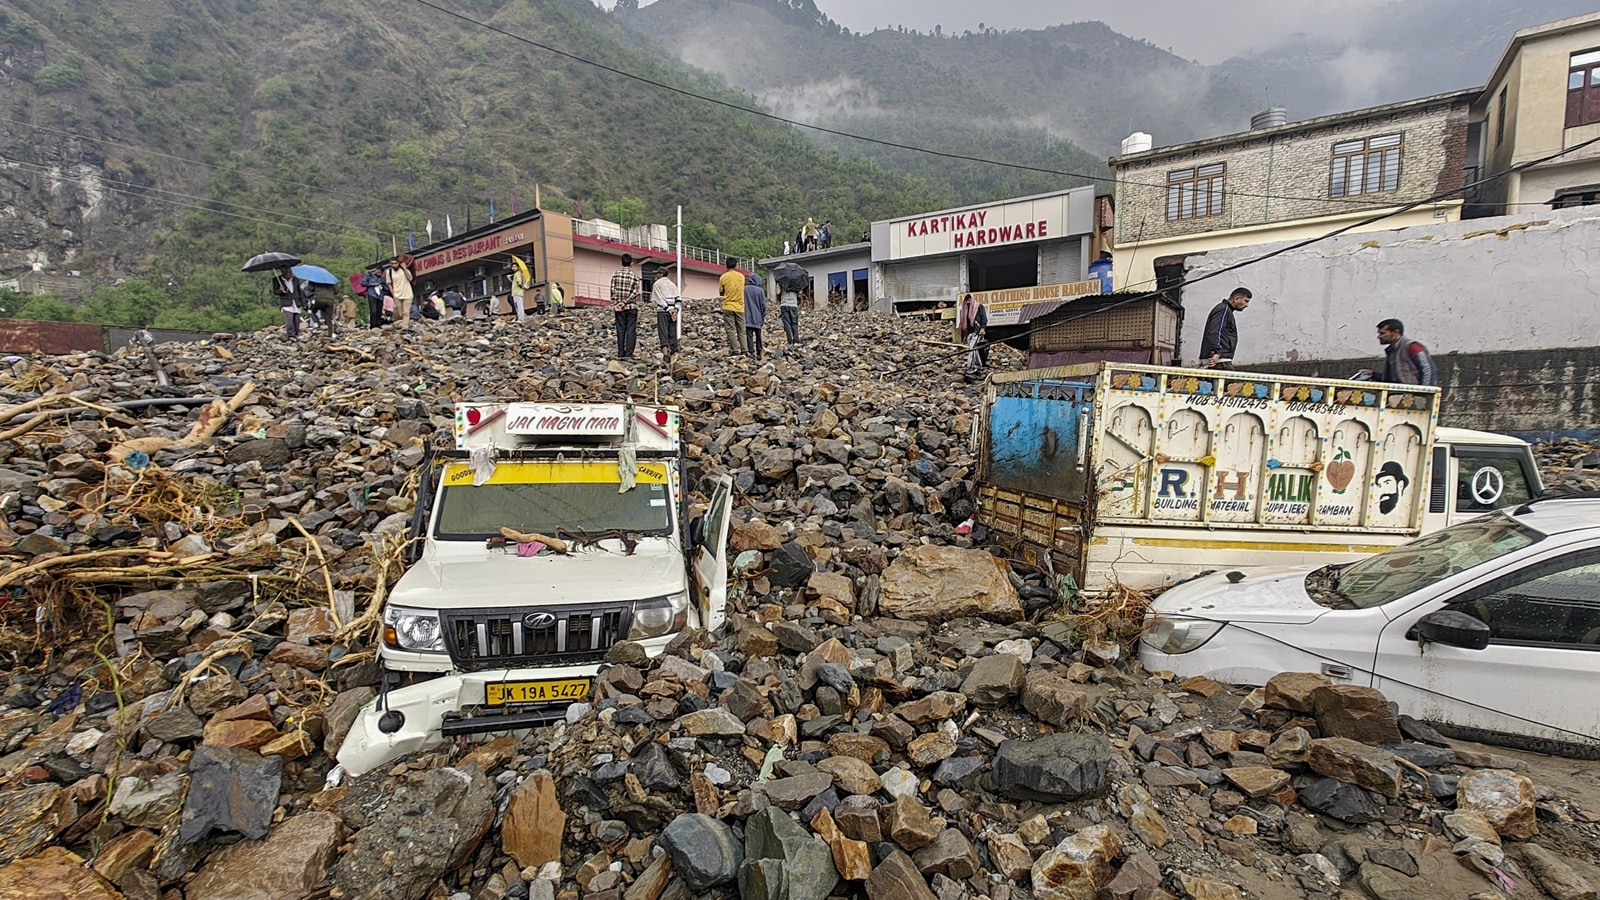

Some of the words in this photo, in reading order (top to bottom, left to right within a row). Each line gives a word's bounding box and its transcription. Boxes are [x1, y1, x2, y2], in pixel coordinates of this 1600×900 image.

[908, 210, 988, 237] KARTIKAY
[954, 220, 1048, 249] HARDWARE
[446, 251, 452, 263] &
[452, 236, 501, 260] RESTAURANT
[991, 288, 1031, 304] CLOTHING
[1033, 285, 1060, 299] HOUSE
[1062, 280, 1100, 296] RAMBAN
[507, 416, 536, 431] JAI
[536, 416, 586, 431] NAGNI
[585, 416, 620, 430] MATA
[451, 468, 472, 481] GOODS
[638, 466, 663, 480] CARRIER
[1154, 498, 1198, 509] BUILDING
[1210, 501, 1250, 512] MATERIAL
[1266, 502, 1306, 514] SUPPLIERS
[497, 687, 514, 700] JK
[521, 686, 546, 699] 19A
[551, 683, 587, 698] 5427
